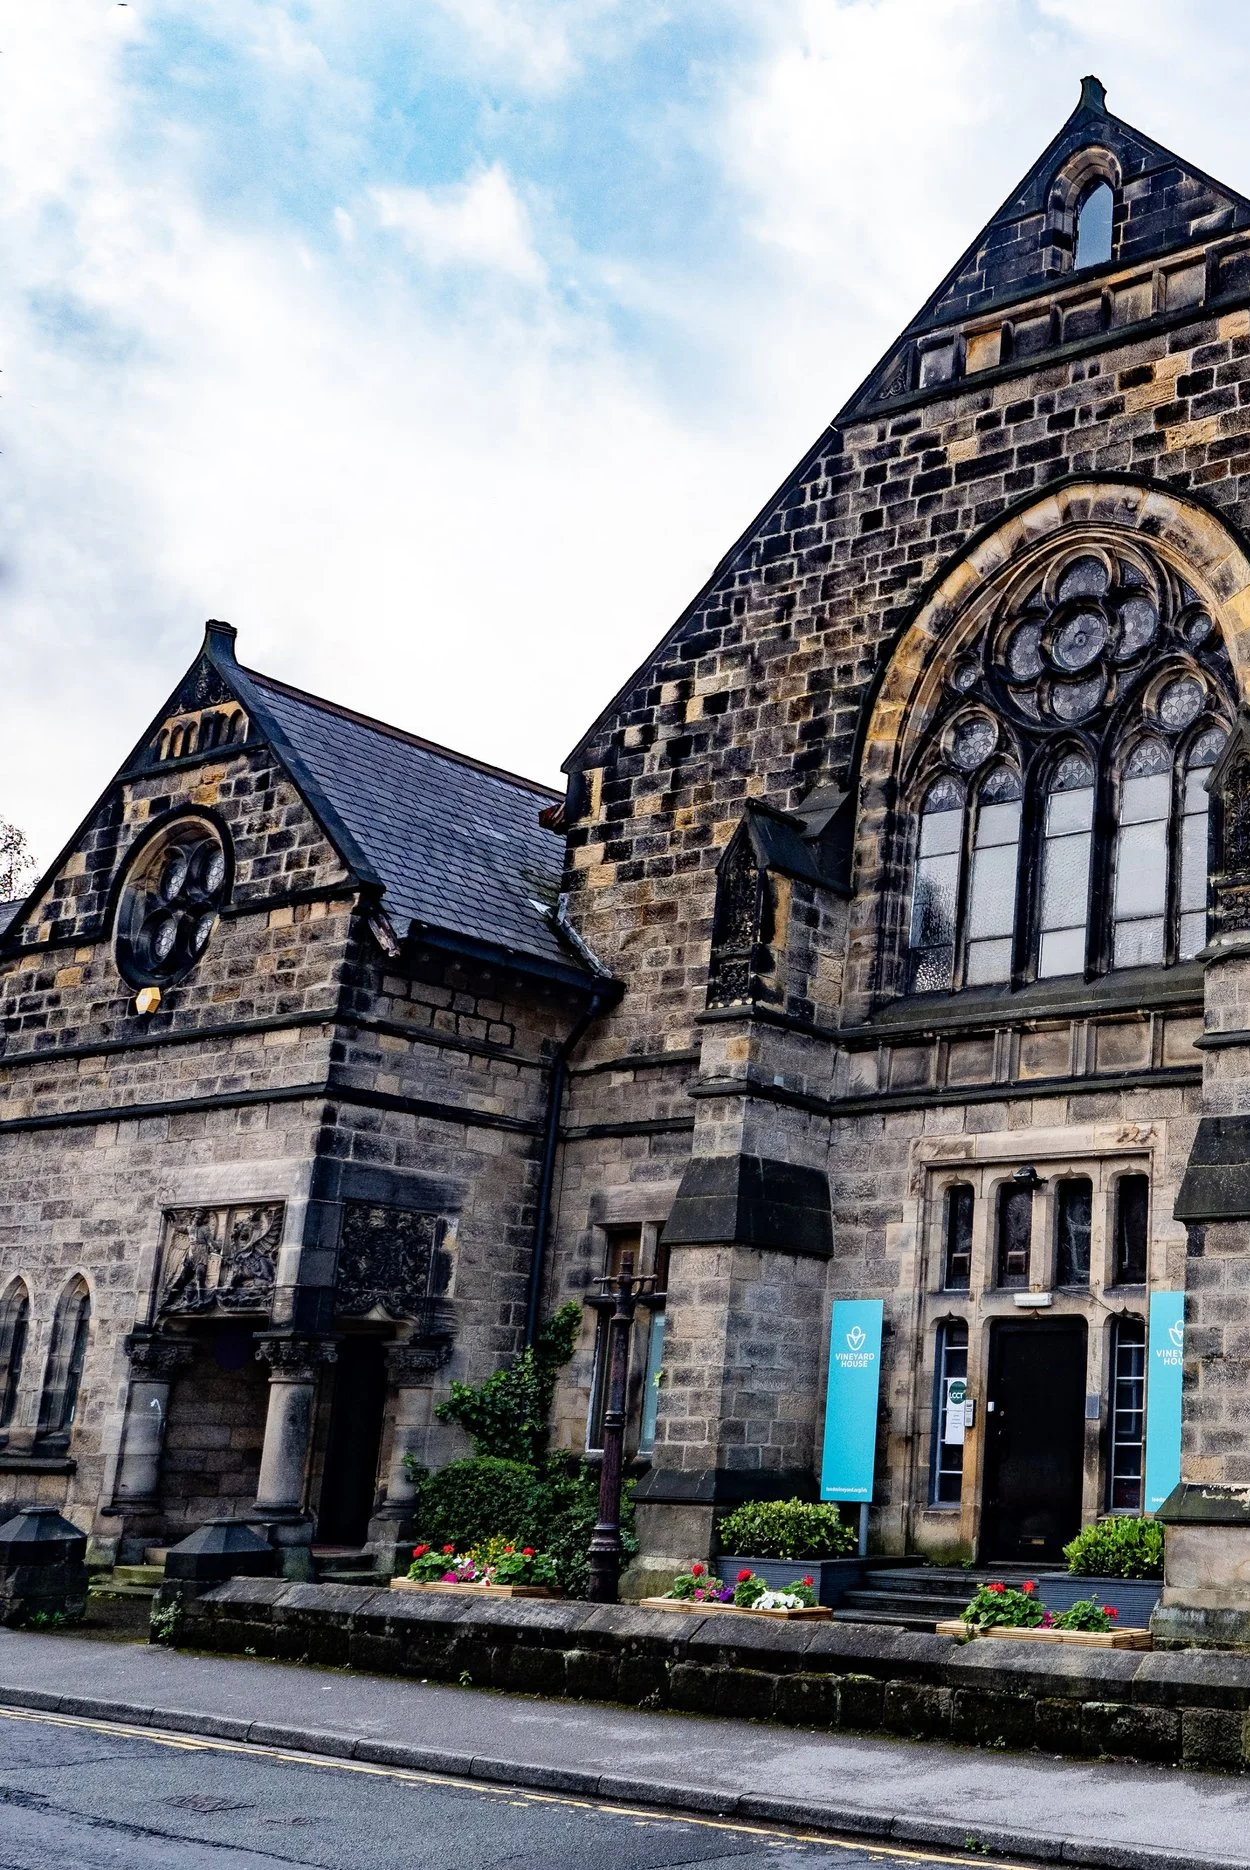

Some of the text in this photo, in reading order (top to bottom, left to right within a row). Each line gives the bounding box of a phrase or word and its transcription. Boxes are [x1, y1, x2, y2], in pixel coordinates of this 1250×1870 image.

[1156, 1350, 1183, 1358] VINEY
[841, 1360, 868, 1368] HOUSE
[1163, 1357, 1184, 1366] HOU
